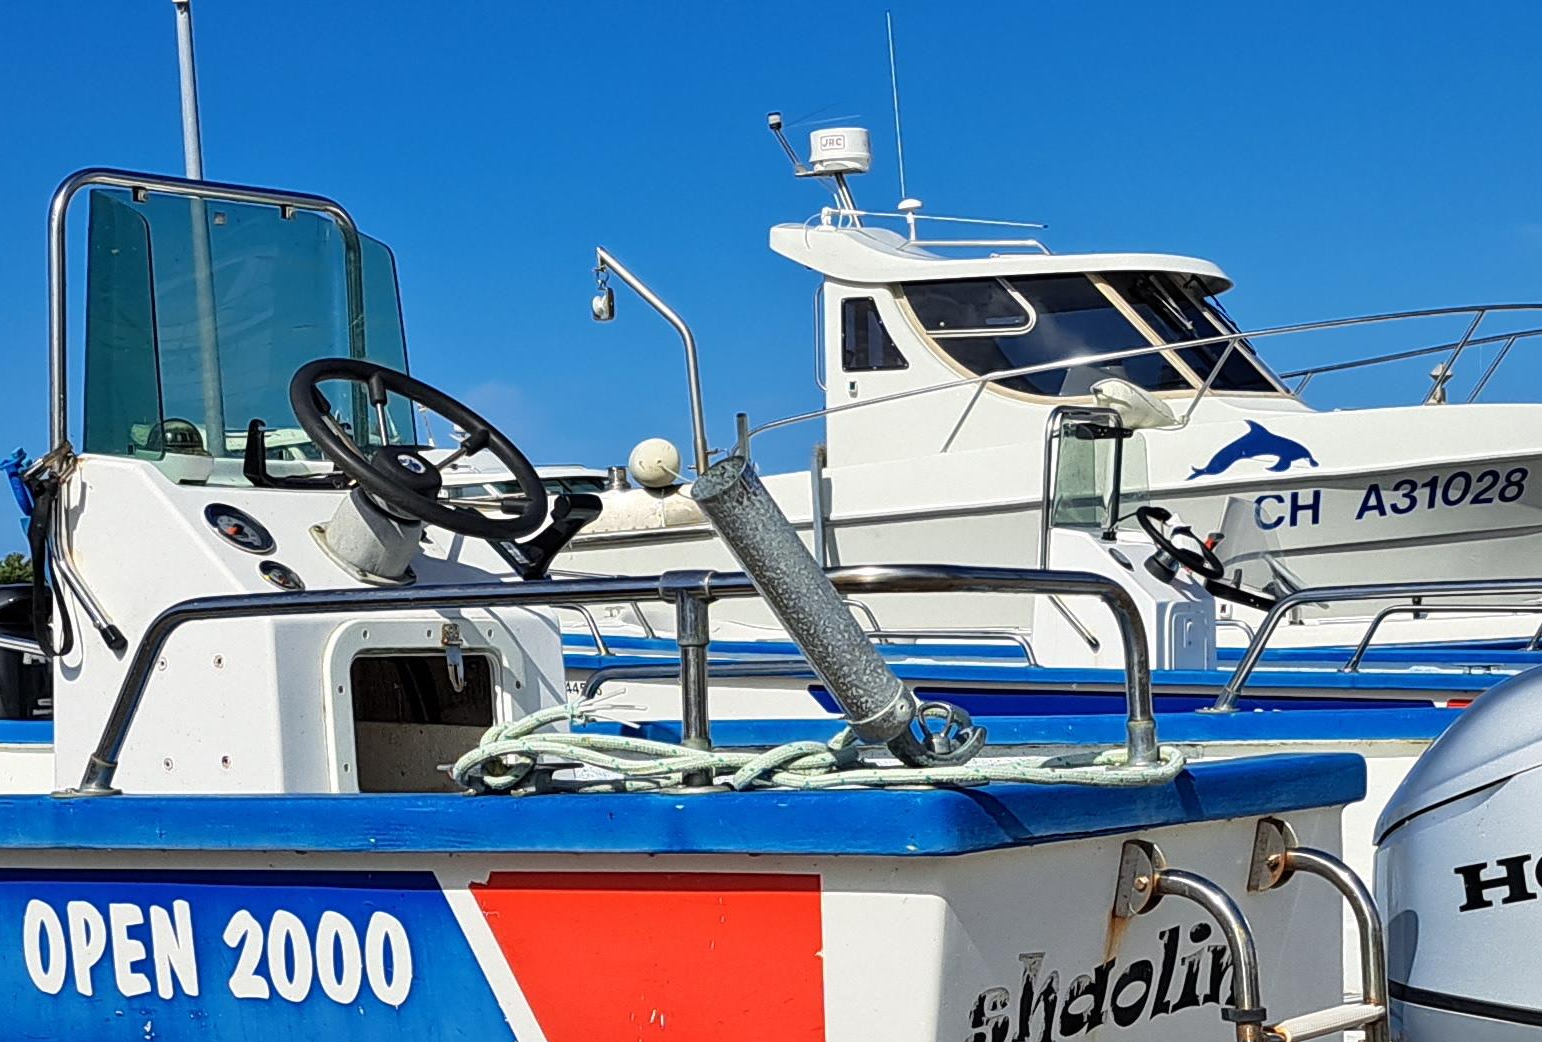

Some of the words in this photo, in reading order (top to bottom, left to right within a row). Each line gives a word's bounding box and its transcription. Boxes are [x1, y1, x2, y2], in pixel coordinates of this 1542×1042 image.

[1254, 489, 1322, 531] CH
[1354, 467, 1530, 521] A31028
[23, 899, 200, 1000] OPEN
[222, 908, 414, 1006] 2000
